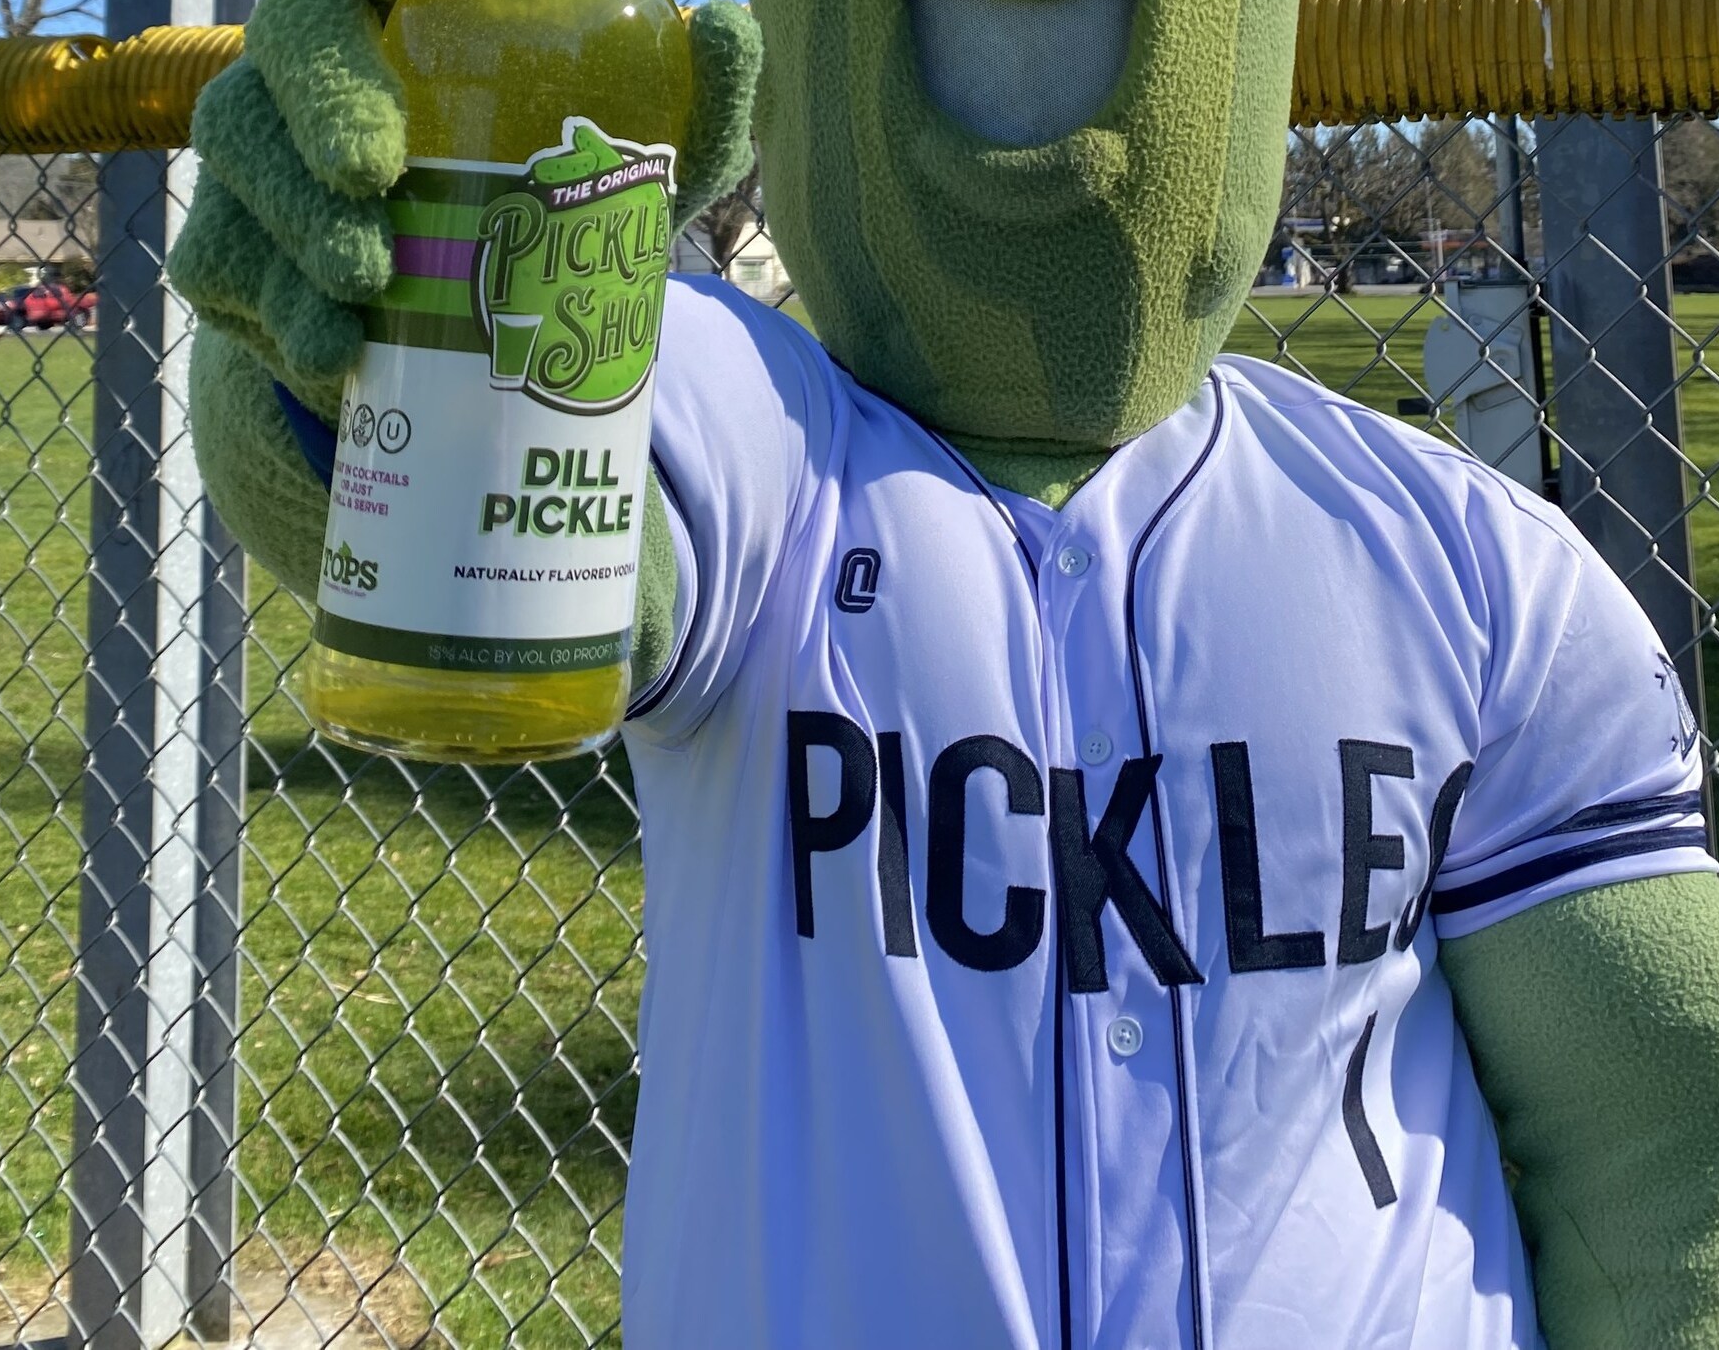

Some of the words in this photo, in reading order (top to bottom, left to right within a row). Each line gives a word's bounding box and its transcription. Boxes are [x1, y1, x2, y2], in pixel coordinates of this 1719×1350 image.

[553, 181, 593, 205] THE
[597, 158, 667, 192] ORIGINAL
[477, 192, 669, 306] PICKLE
[351, 482, 374, 497] JUST
[352, 465, 410, 487] COCKTAILS
[520, 446, 619, 490] DILL
[479, 492, 633, 538] PICKLE
[323, 547, 379, 591] TOPS
[454, 565, 545, 582] NATURALLY
[548, 566, 612, 582] FLAVORED
[459, 648, 490, 663] ALC
[494, 649, 514, 664] BY
[517, 650, 546, 665] VOL
[549, 648, 570, 666] (30
